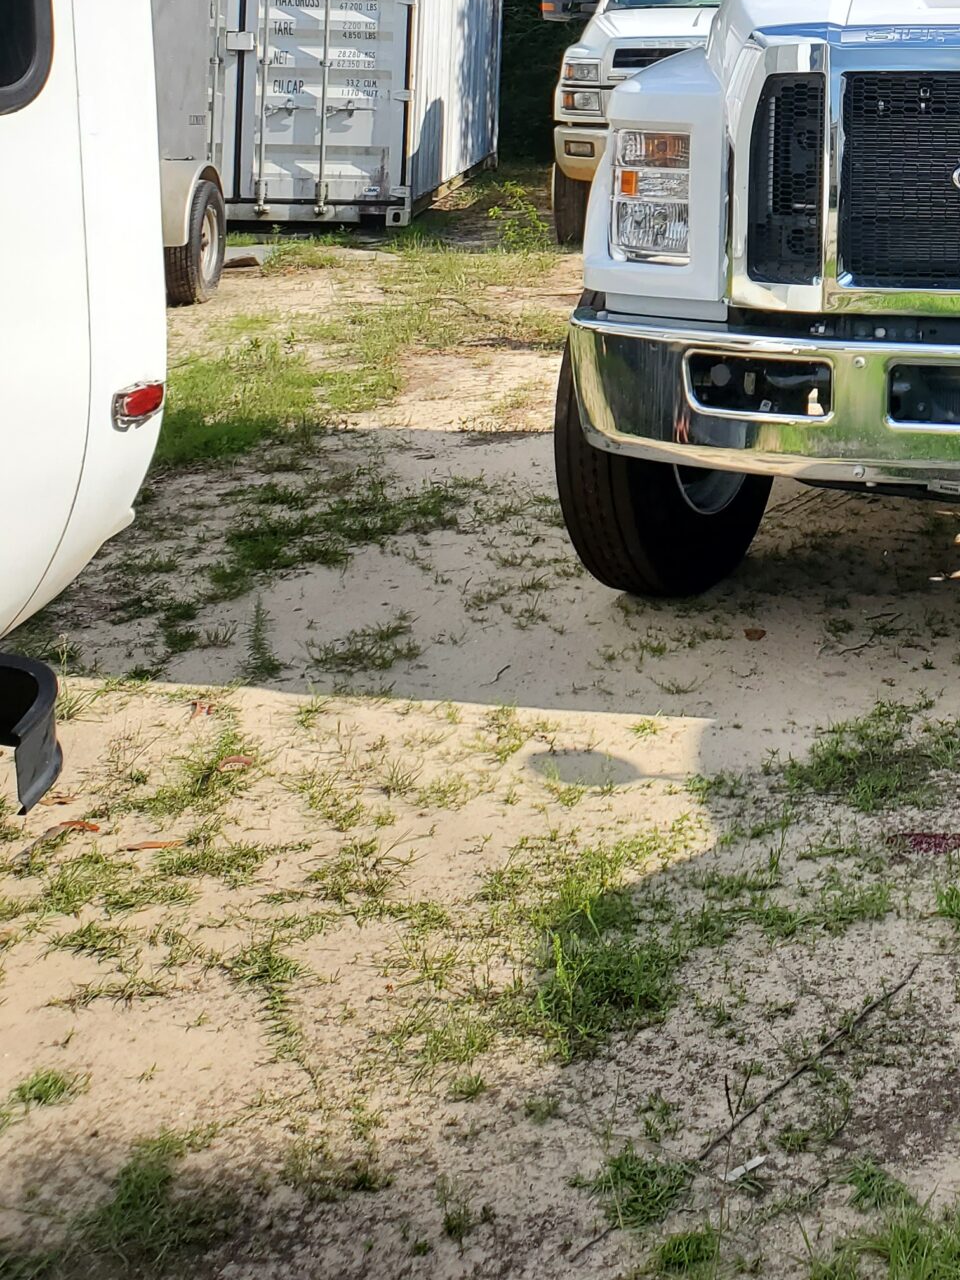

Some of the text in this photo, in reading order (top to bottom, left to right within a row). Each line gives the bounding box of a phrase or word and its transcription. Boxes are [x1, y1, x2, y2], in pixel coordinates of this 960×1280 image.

[366, 3, 378, 11] LBS
[273, 21, 294, 36] TARE
[365, 32, 377, 40] LBS
[273, 50, 289, 65] NET
[363, 60, 375, 69] LBS
